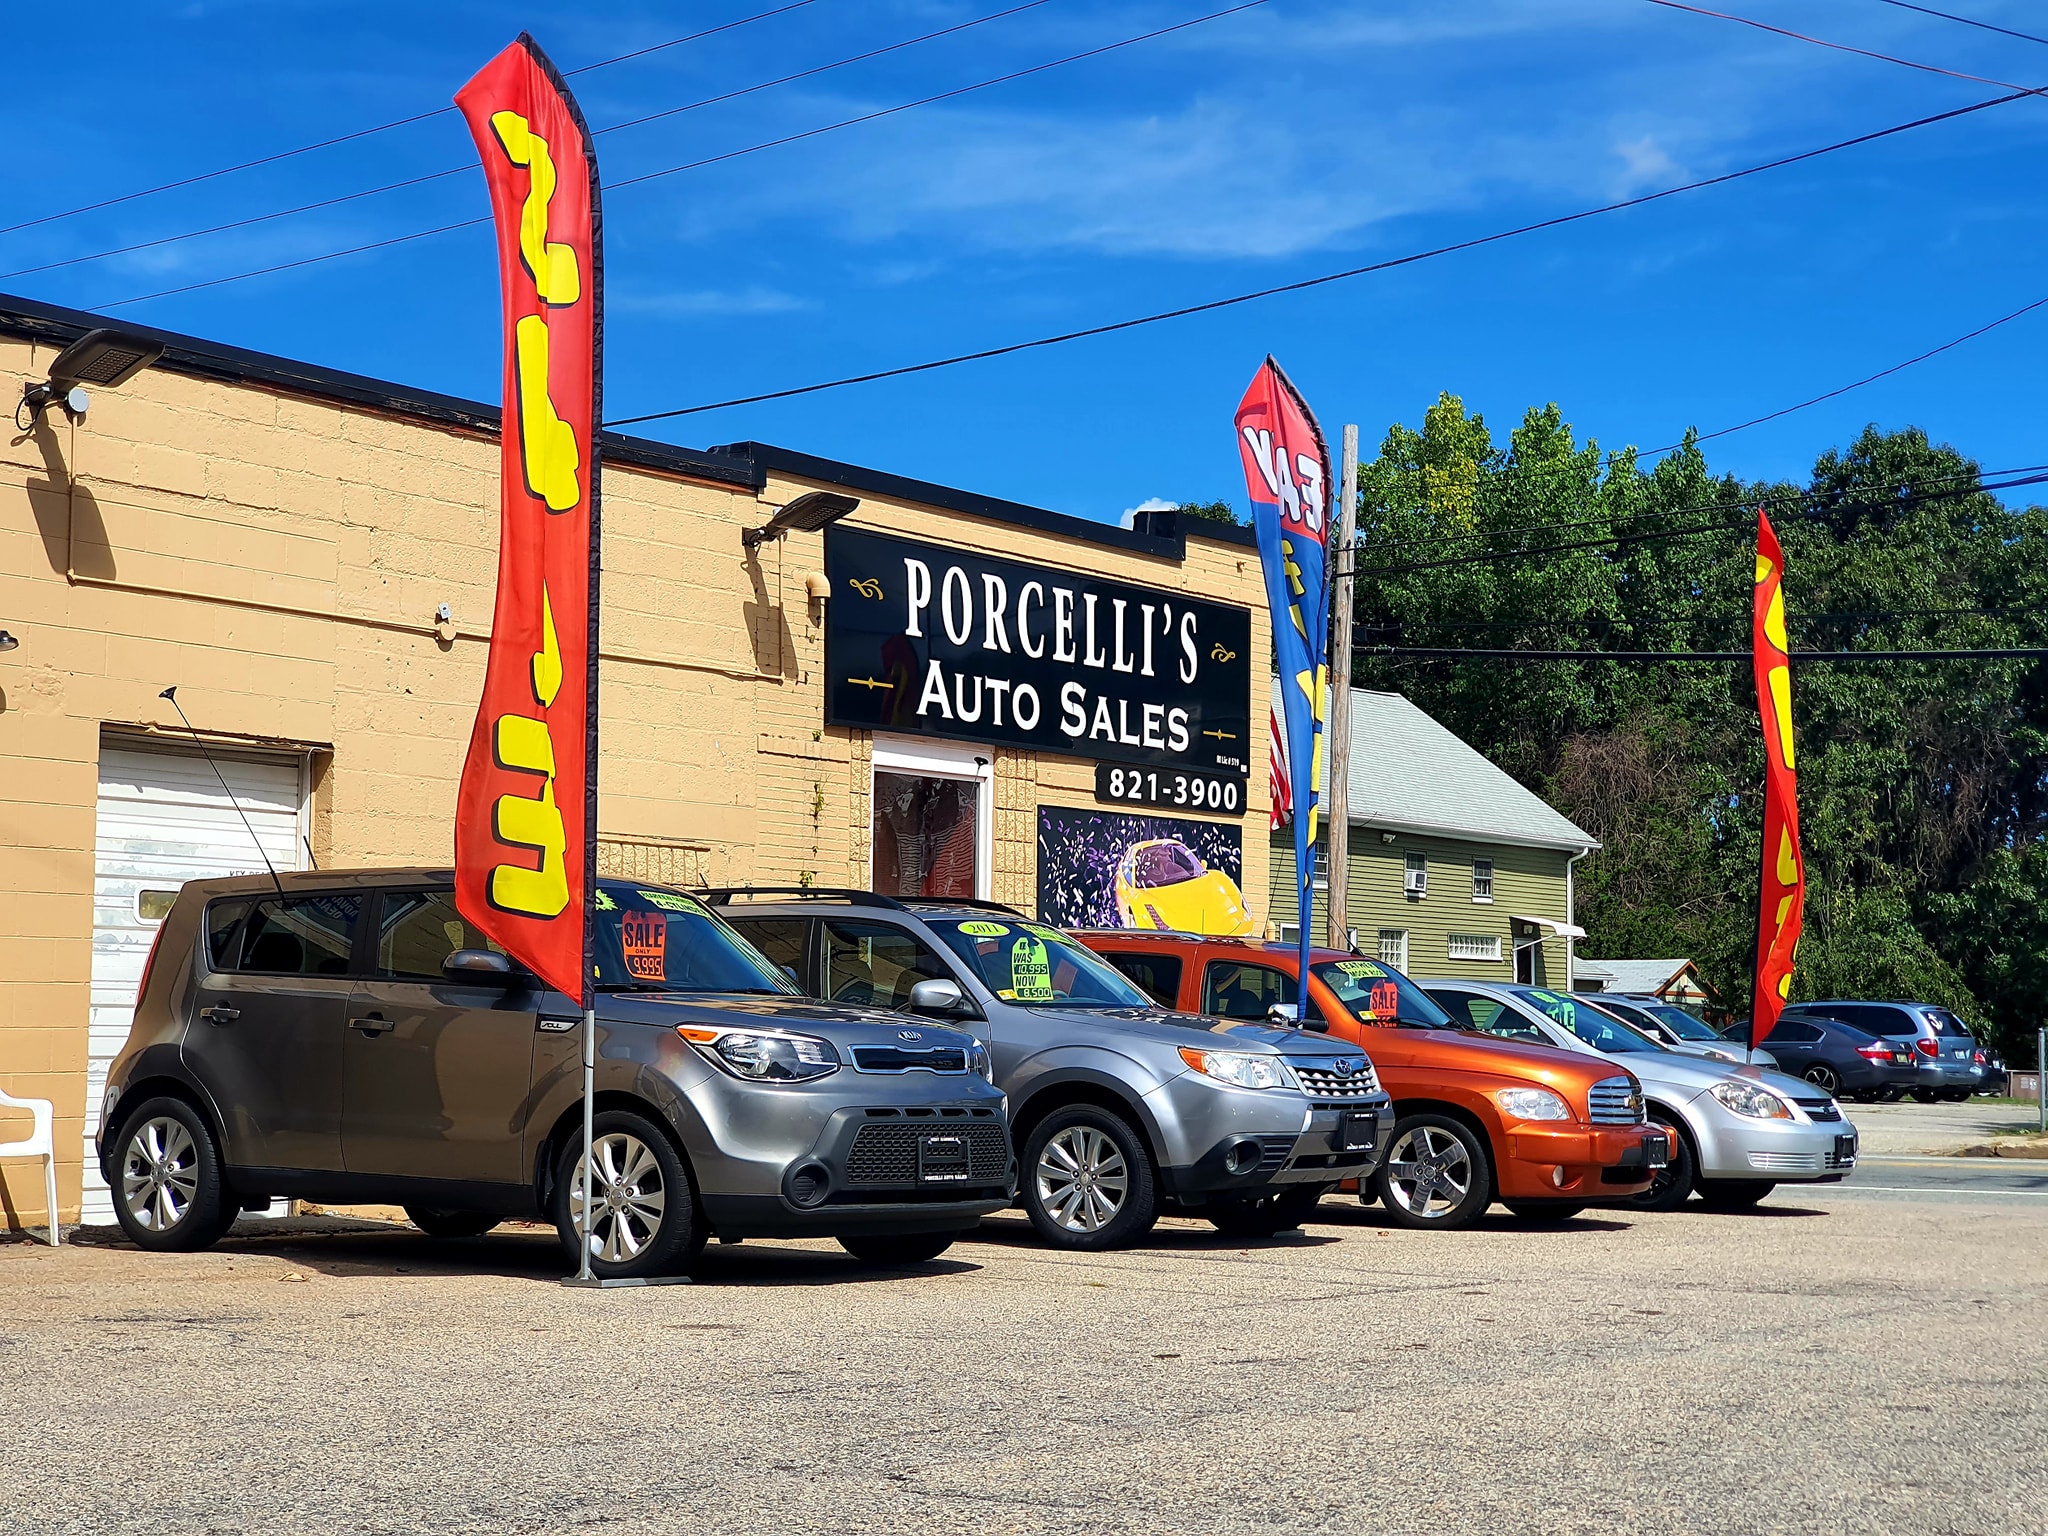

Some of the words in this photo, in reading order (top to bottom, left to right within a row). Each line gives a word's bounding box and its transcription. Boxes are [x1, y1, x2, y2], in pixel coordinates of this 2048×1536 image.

[903, 557, 1199, 685] PORCELLI'S
[916, 659, 1041, 731] AUTO
[1060, 681, 1191, 753] SALES
[1108, 768, 1238, 811] 821-3900
[625, 923, 665, 948] SALE
[968, 924, 999, 934] 2011
[1013, 953, 1033, 963] WAS
[1016, 976, 1037, 987] NOW
[1371, 991, 1397, 1009] SALE
